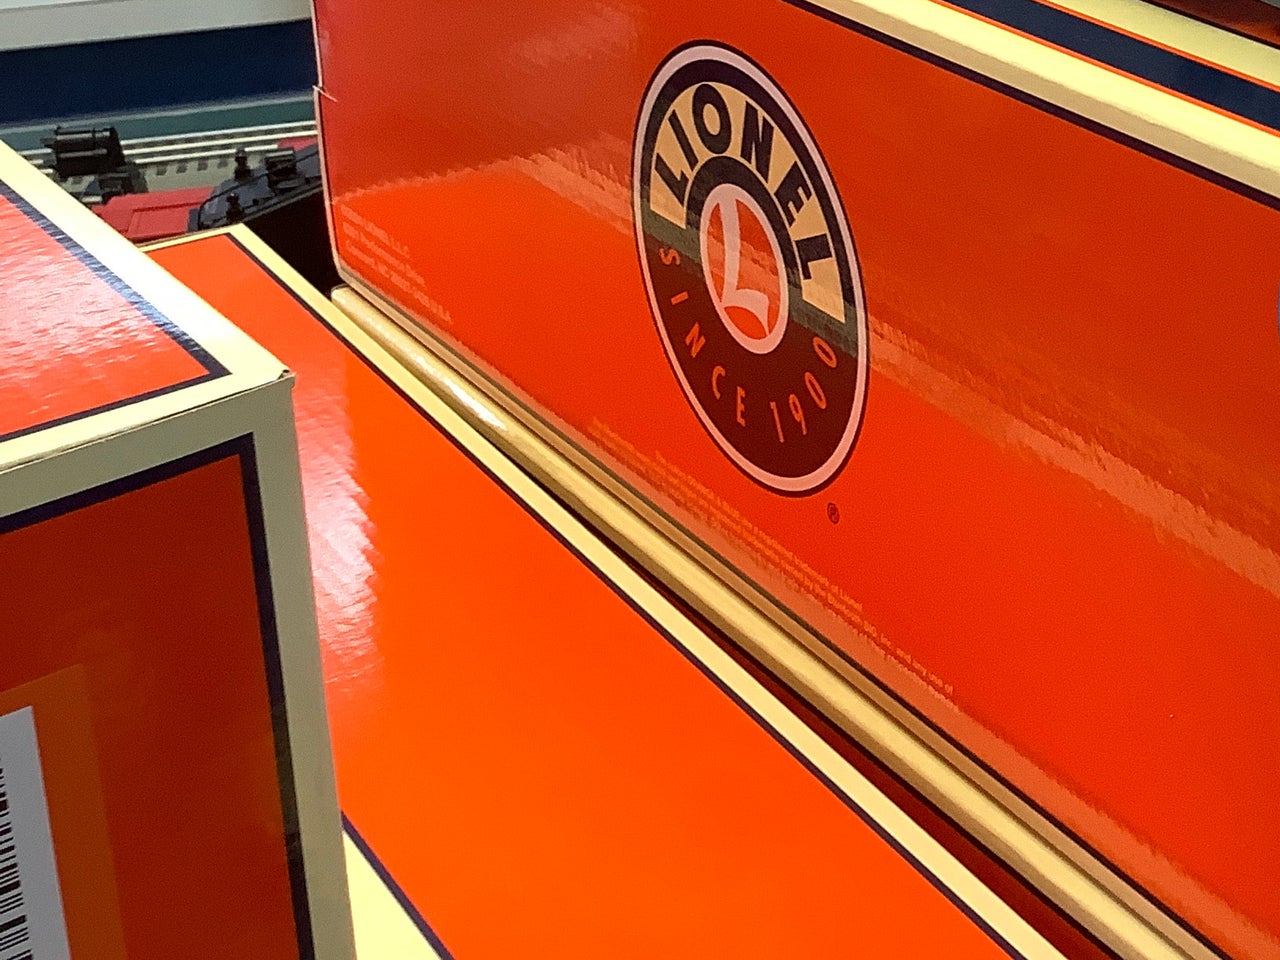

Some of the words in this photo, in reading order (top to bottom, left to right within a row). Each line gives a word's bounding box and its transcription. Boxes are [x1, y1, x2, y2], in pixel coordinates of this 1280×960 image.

[654, 82, 833, 280] LIONEL
[659, 248, 747, 427] SINCE
[770, 336, 837, 443] 1900
